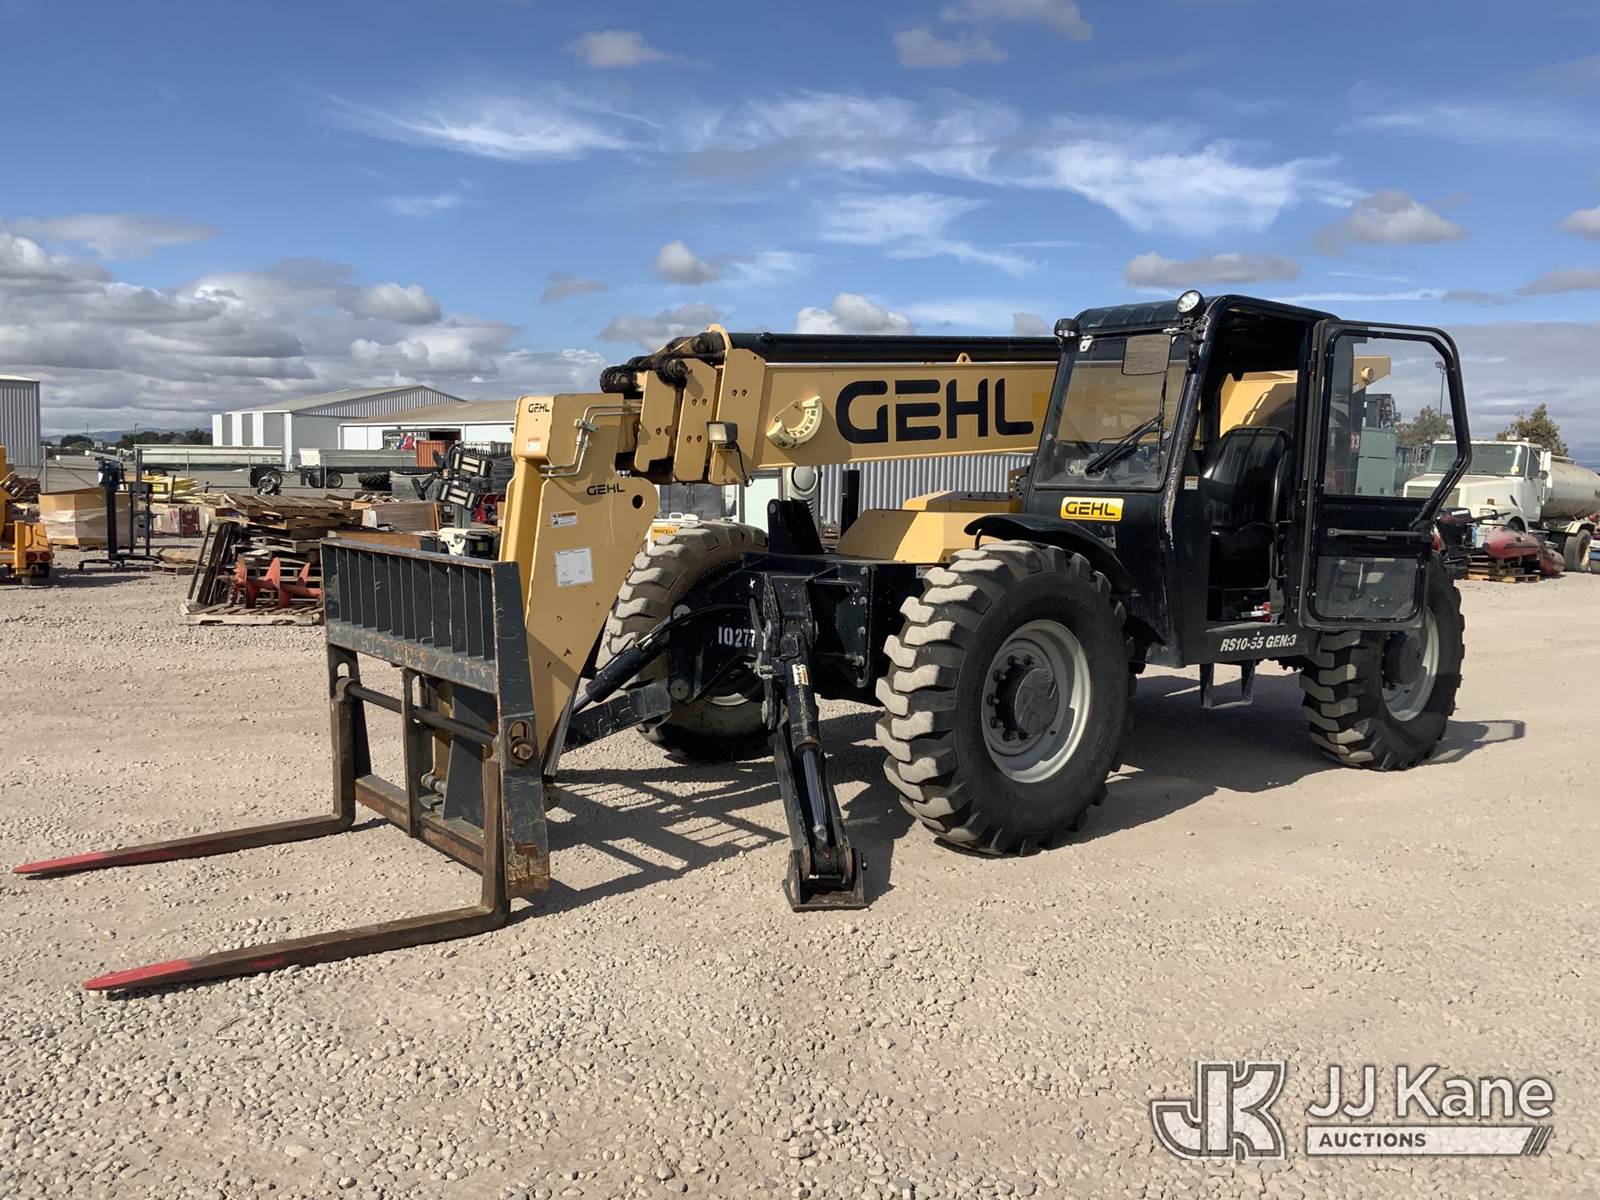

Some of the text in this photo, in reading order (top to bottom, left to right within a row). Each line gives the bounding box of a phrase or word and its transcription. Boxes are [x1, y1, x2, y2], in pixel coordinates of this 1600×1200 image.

[528, 403, 550, 413] GEHL
[835, 378, 1034, 444] GEHL
[586, 483, 625, 496] GEHL
[1065, 501, 1116, 516] GEHL
[1220, 636, 1264, 652] RS10-55
